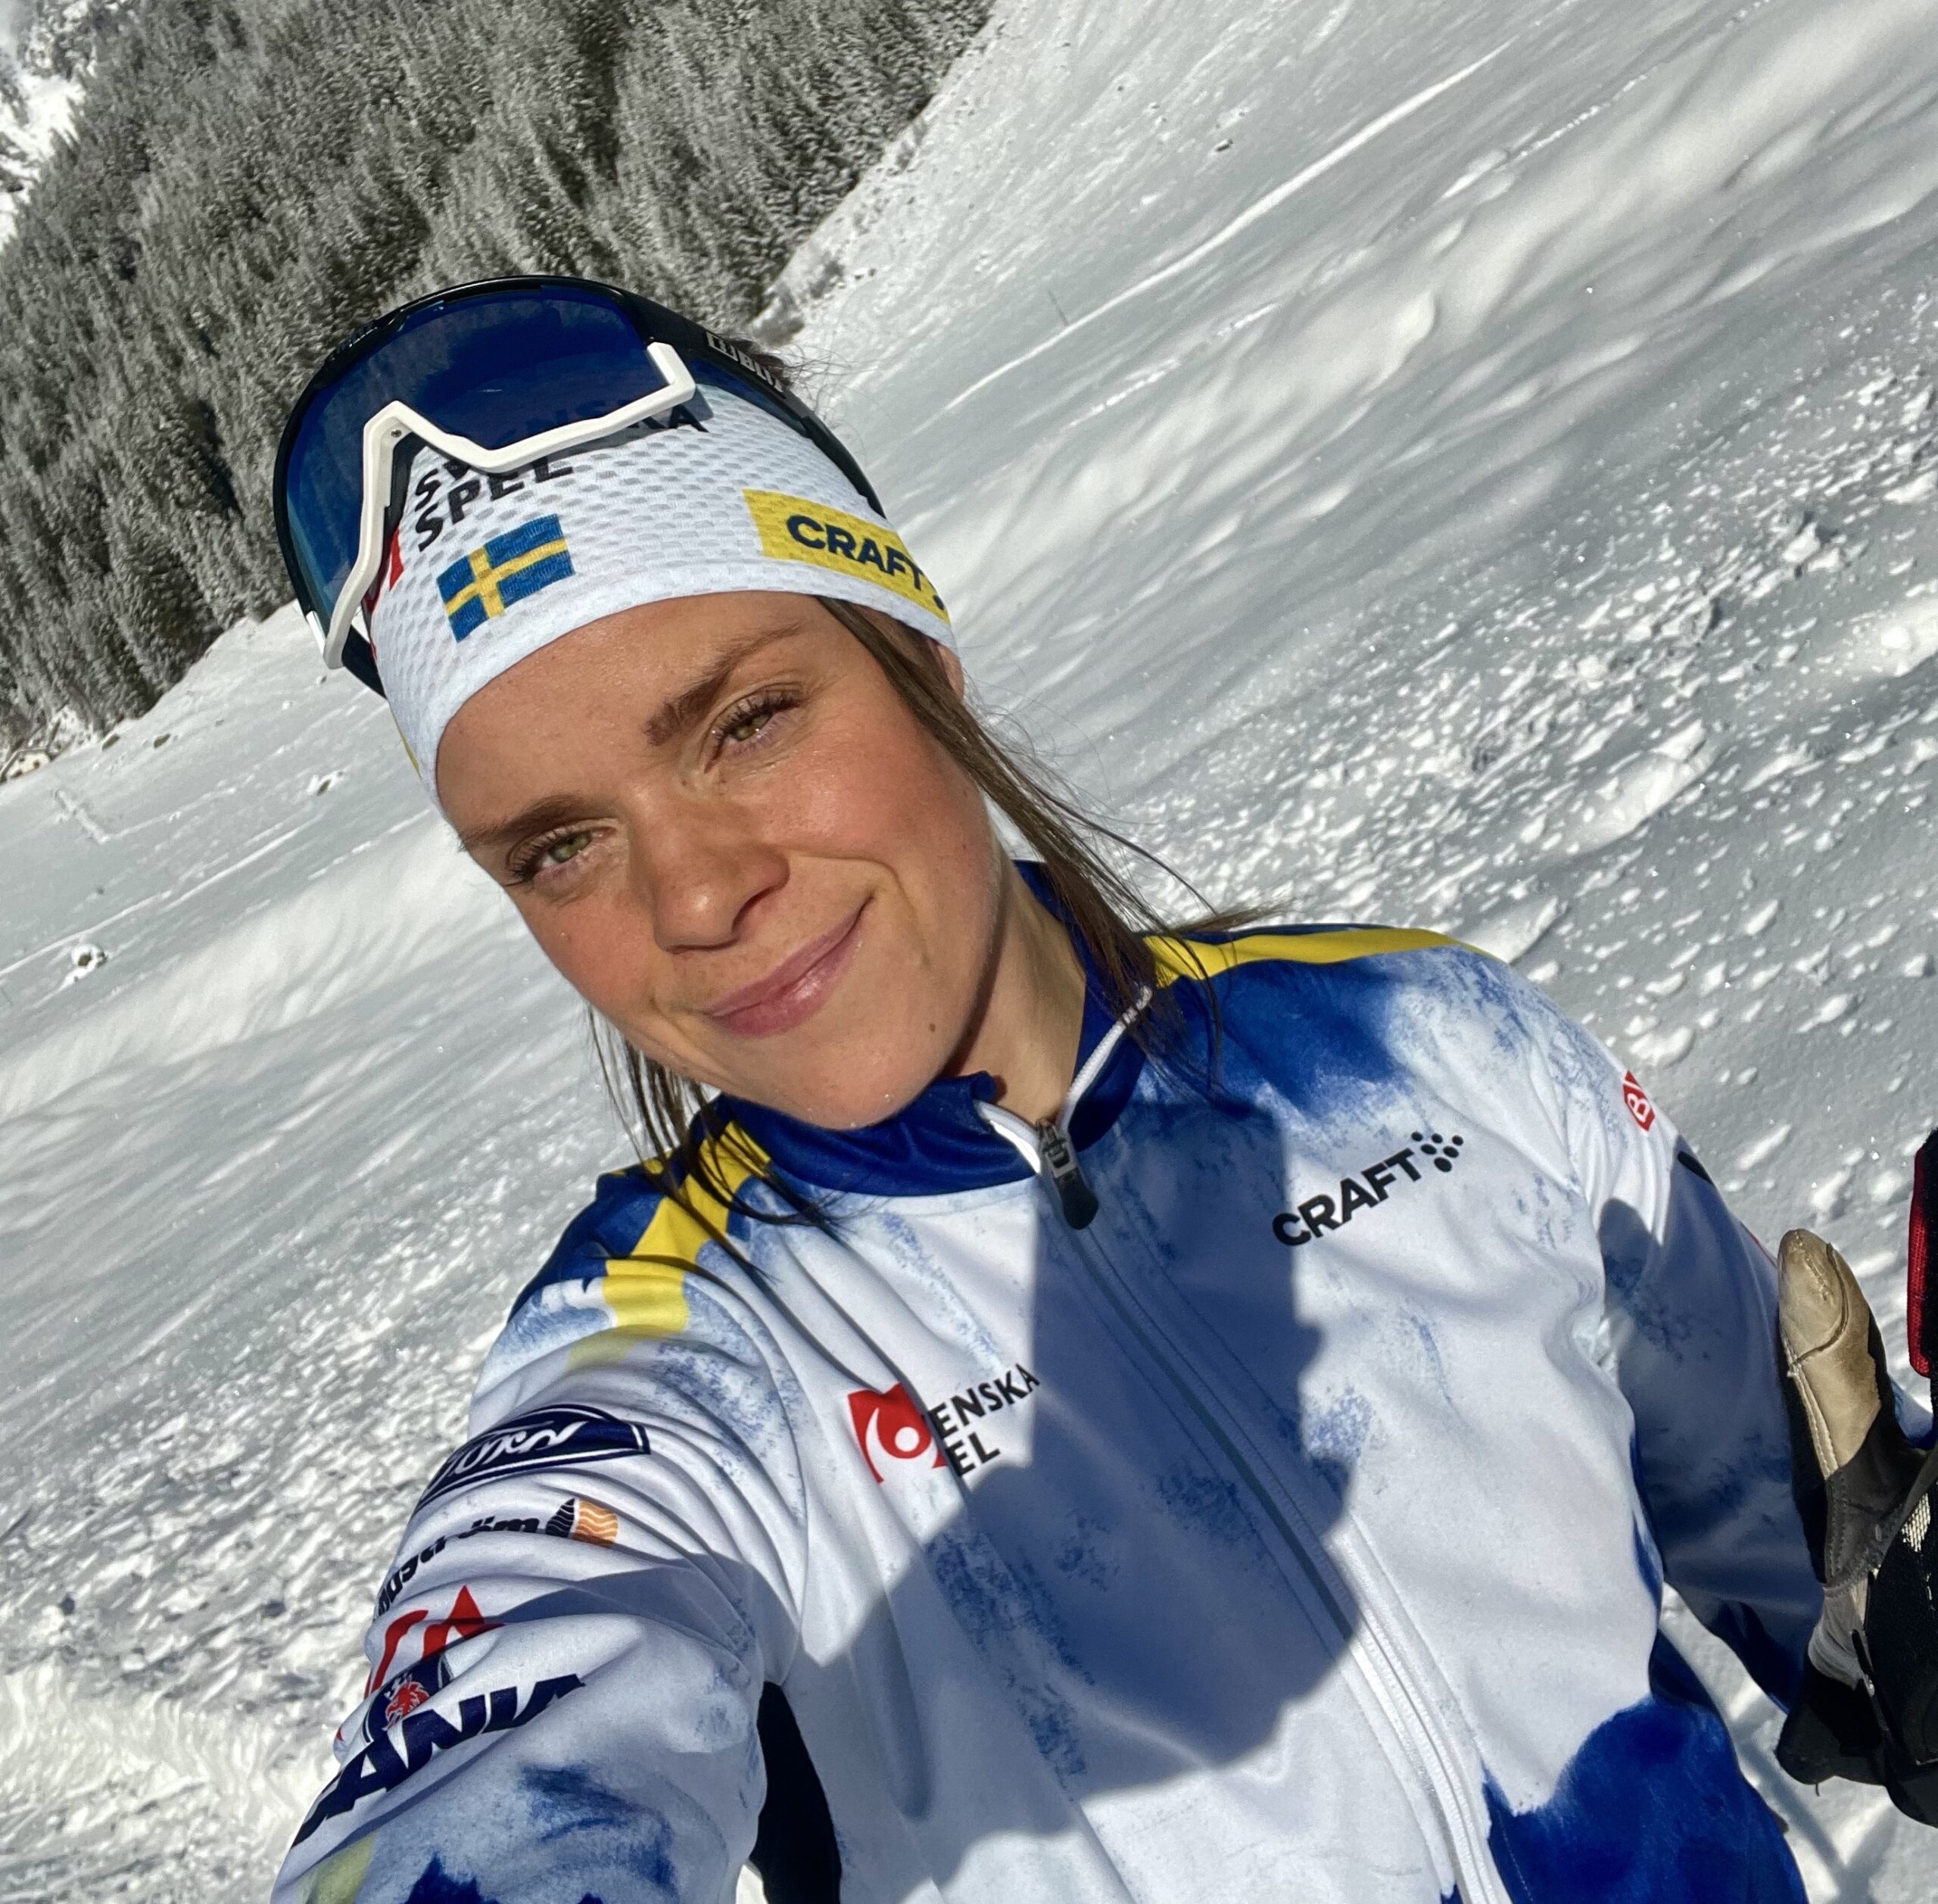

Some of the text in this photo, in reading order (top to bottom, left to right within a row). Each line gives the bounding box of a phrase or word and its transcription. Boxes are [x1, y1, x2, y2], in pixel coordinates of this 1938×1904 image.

[787, 514, 925, 591] CRAFT
[1272, 1147, 1422, 1246] CRAFT
[927, 1363, 1041, 1439] ENSKA
[945, 1432, 1001, 1477] EL
[291, 1673, 586, 1848] ANIA
